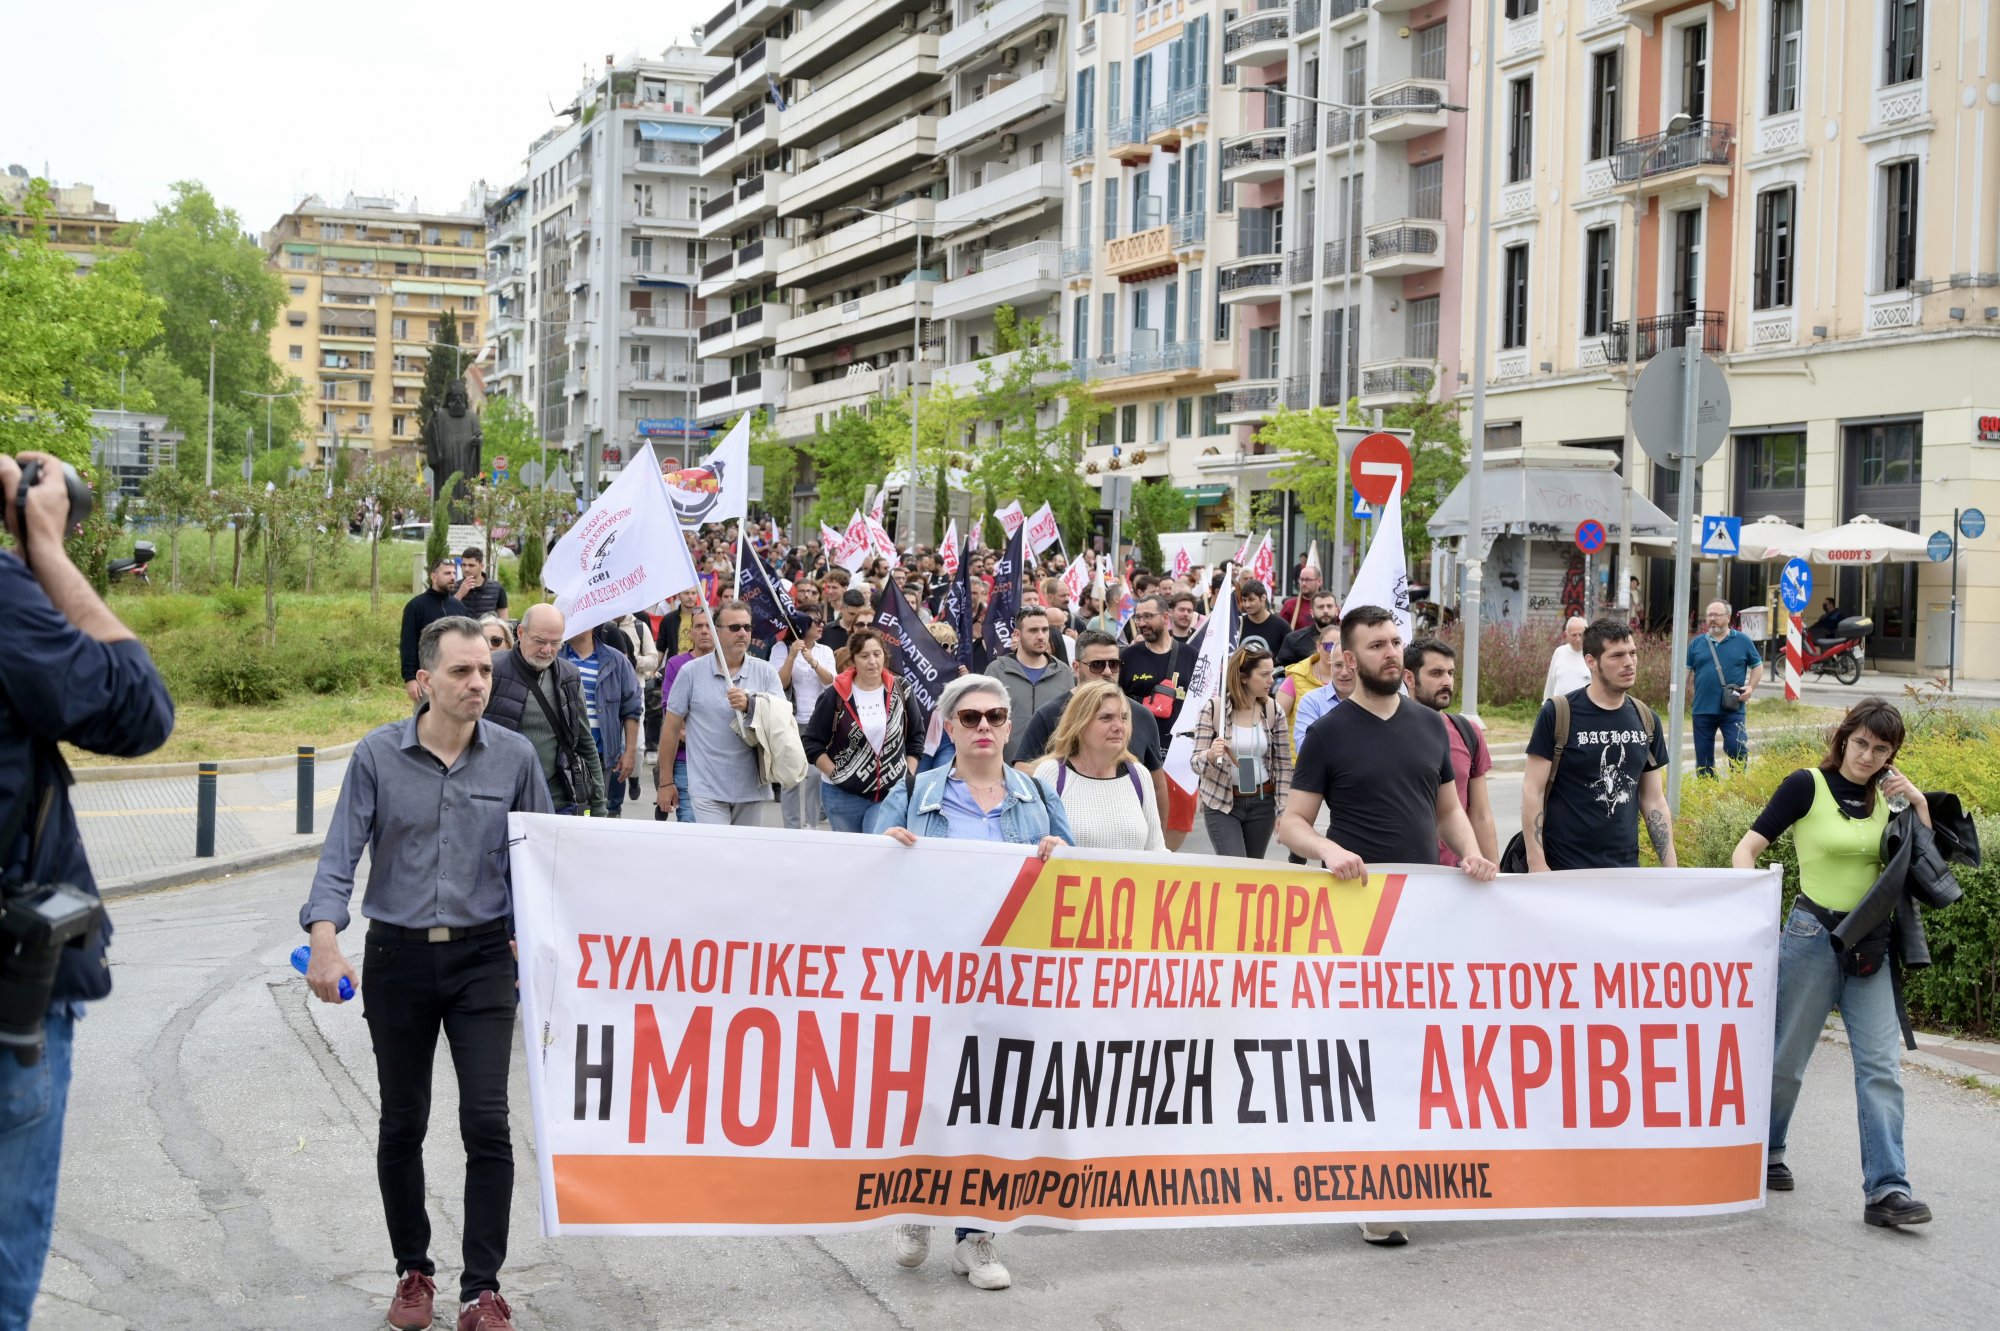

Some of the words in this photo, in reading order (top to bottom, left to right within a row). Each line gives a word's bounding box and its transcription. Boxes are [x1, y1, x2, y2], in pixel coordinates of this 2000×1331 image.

[1051, 876, 1135, 949] ΕΔΩ
[1151, 880, 1219, 951] ΚΑΙ
[1236, 884, 1341, 953] ΤΩΡΑ
[577, 934, 845, 999] ΣΥΛΛΟΓΙΚΕΣ
[860, 947, 1082, 1008] ΣΥΜΒΑΣΕΙΣ
[1094, 957, 1223, 1008] ΕΡΓΑΣΙΑΣ
[1232, 959, 1278, 1008] ΜΕ
[1293, 962, 1458, 1009] ΑΥΞΗΣΕΙΣ
[1467, 963, 1580, 1009] ΣΤΟΥΣ
[1594, 962, 1753, 1009] ΜΙΣΘΟΥΣ
[574, 1023, 615, 1121] Η
[628, 1003, 931, 1149] ΜΟΝΗ
[946, 1035, 1214, 1130] ΑΠΑΝΤΗΣΗ
[1233, 1038, 1376, 1123] ΣΤΗΝ
[1418, 1024, 1746, 1129] ΑΚΡΙΒΕΙΑ
[855, 1168, 953, 1211] ΕΝΩΣΗ
[960, 1164, 1241, 1211] ΕΜΠΟΡΟΫΠΑΛΛΗΛΩΝ
[1253, 1166, 1283, 1203] Ν.
[1294, 1163, 1493, 1202] ΘΕΣΣΑΛΟΝΙΚΗΣ
